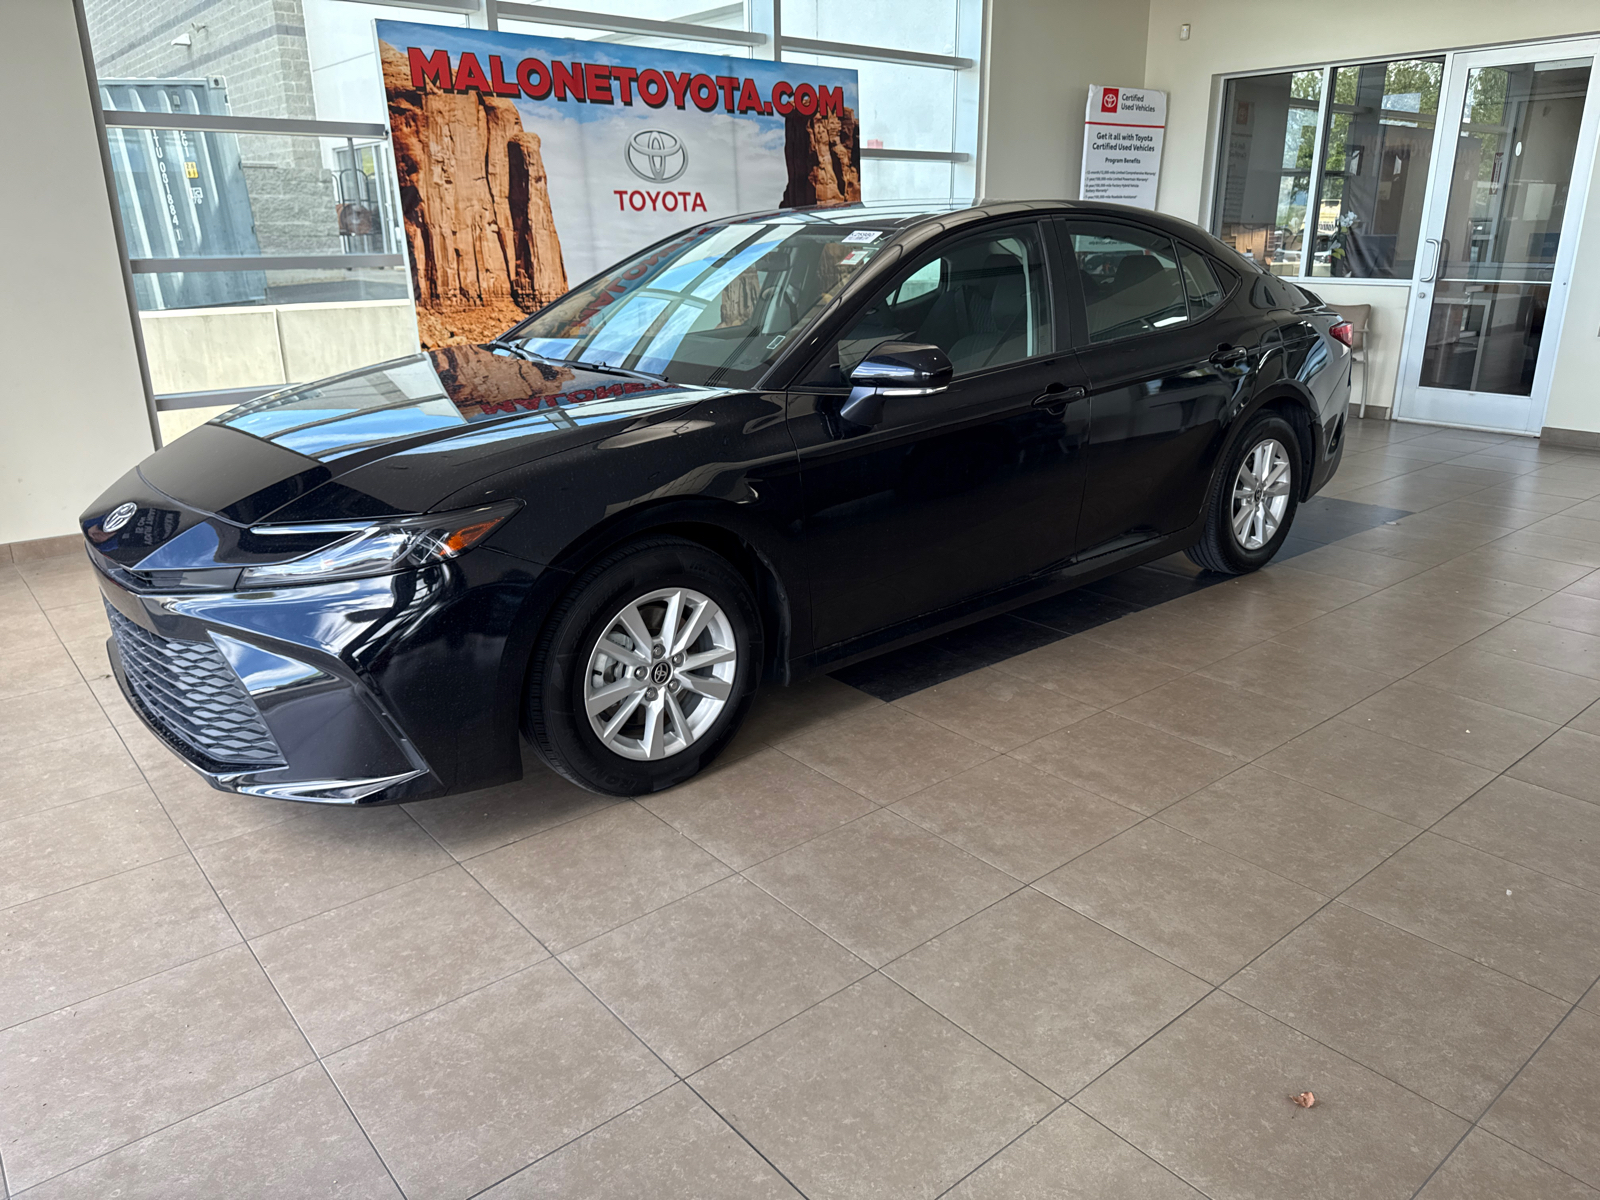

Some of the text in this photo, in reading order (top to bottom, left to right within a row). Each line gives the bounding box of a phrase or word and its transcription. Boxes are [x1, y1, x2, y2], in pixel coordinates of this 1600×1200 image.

[407, 47, 845, 120] MALONETOYOTA.COM
[1121, 93, 1144, 102] Certified
[1121, 103, 1155, 112] Used Vehicles
[1096, 132, 1107, 140] Get
[1108, 132, 1113, 140] it
[1122, 133, 1134, 141] with
[1135, 134, 1153, 143] Toyota
[1092, 142, 1155, 152] Certified Used Vehicles
[1105, 157, 1123, 165] Program
[613, 189, 708, 212] TOYOTA
